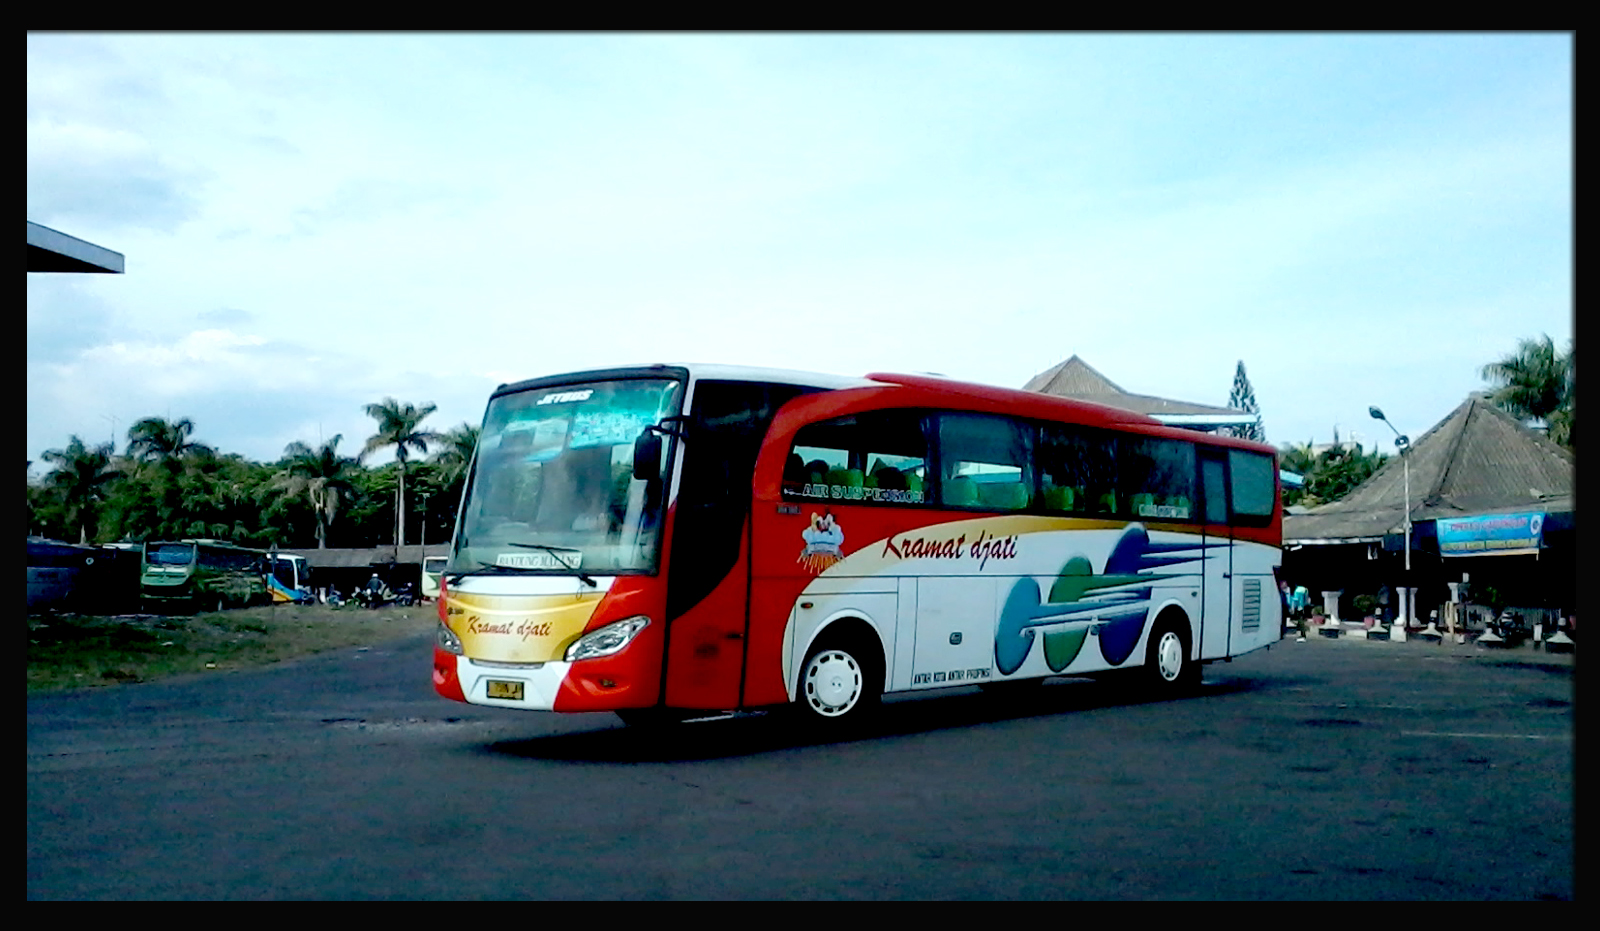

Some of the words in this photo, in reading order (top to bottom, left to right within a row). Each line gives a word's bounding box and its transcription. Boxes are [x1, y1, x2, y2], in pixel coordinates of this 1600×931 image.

[802, 483, 829, 499] AIR
[831, 485, 924, 504] SUSPENSION
[882, 533, 966, 560] Kramat
[970, 529, 1018, 571] djati
[467, 615, 514, 634] Kramat
[516, 618, 553, 642] djati
